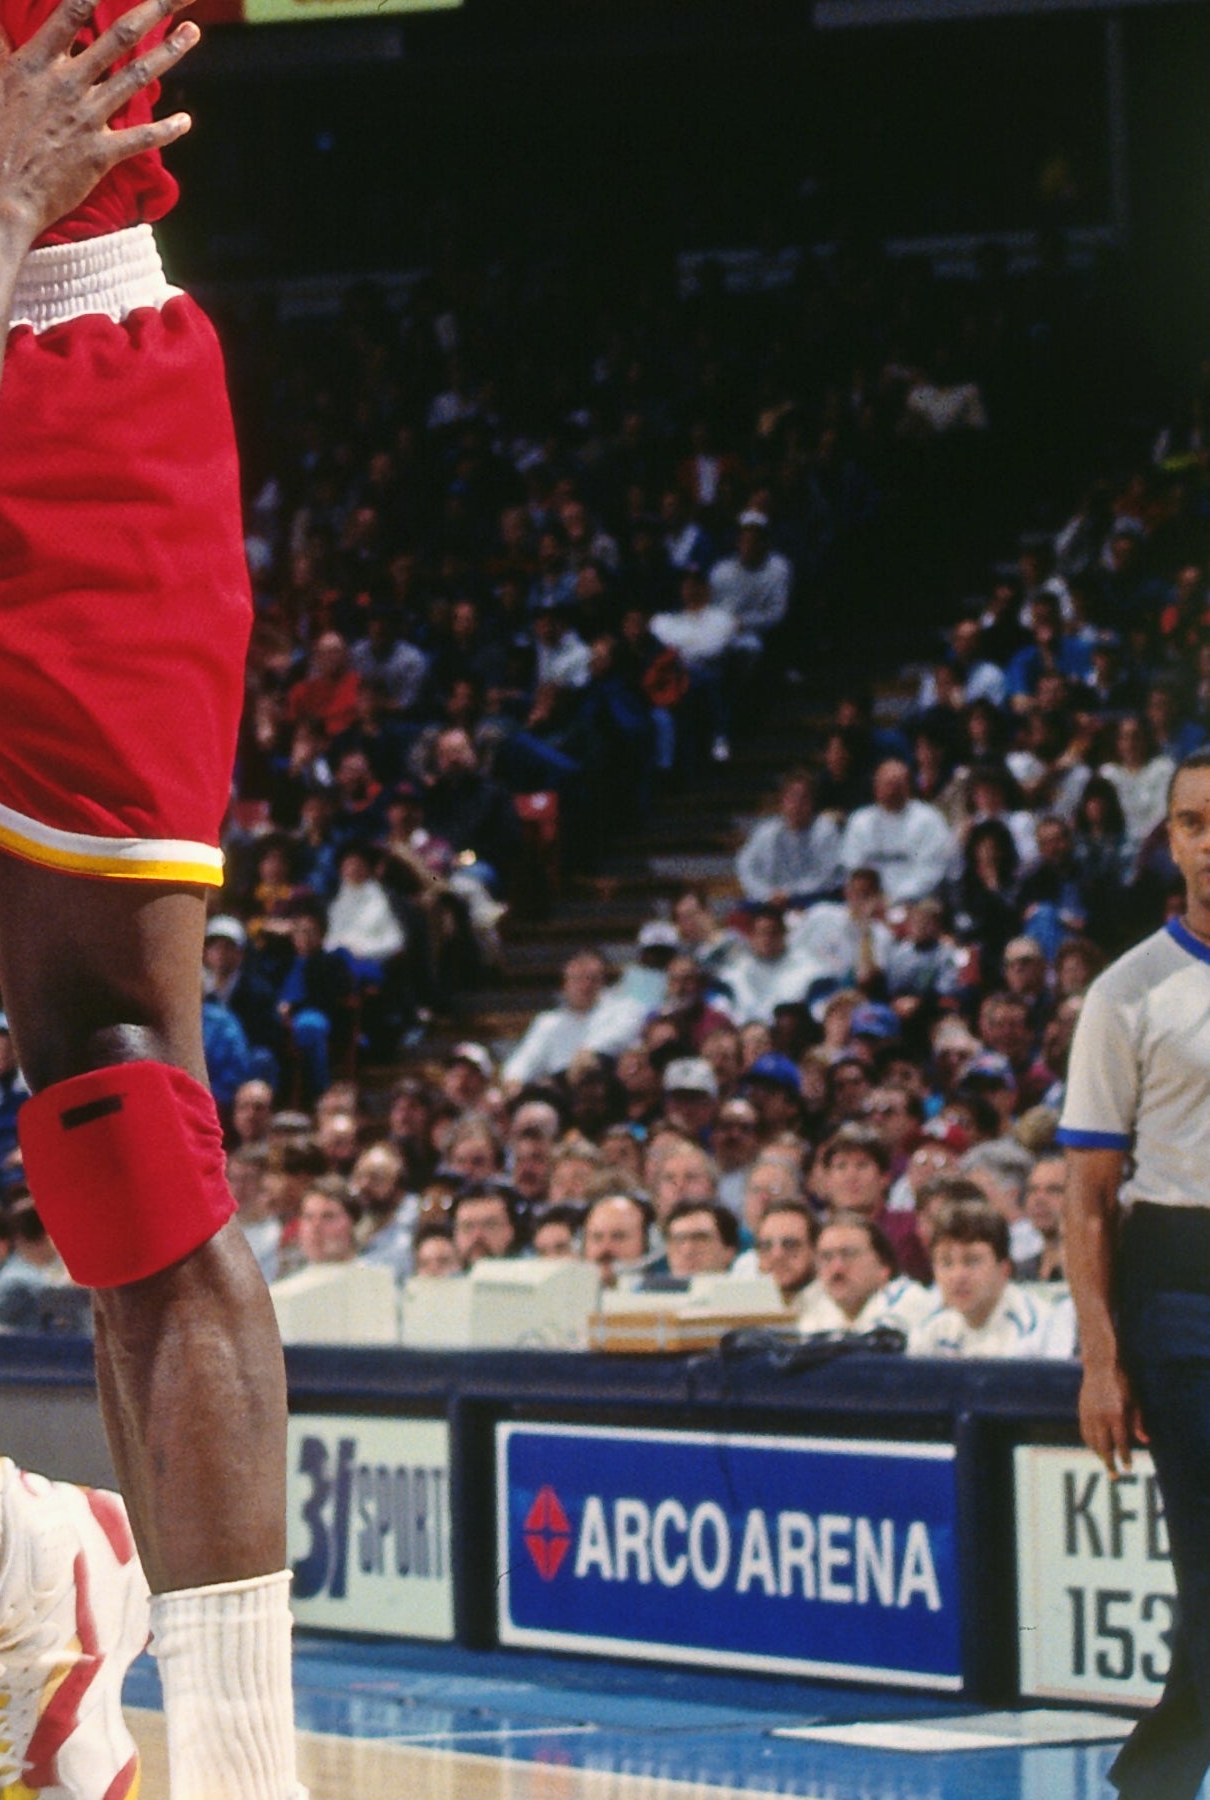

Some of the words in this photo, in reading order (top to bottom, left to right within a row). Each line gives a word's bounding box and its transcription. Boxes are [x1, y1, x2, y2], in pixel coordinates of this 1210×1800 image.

[574, 1494, 729, 1590] ARCO
[735, 1509, 942, 1611] ARENA
[1067, 1586, 1176, 1683] 153
